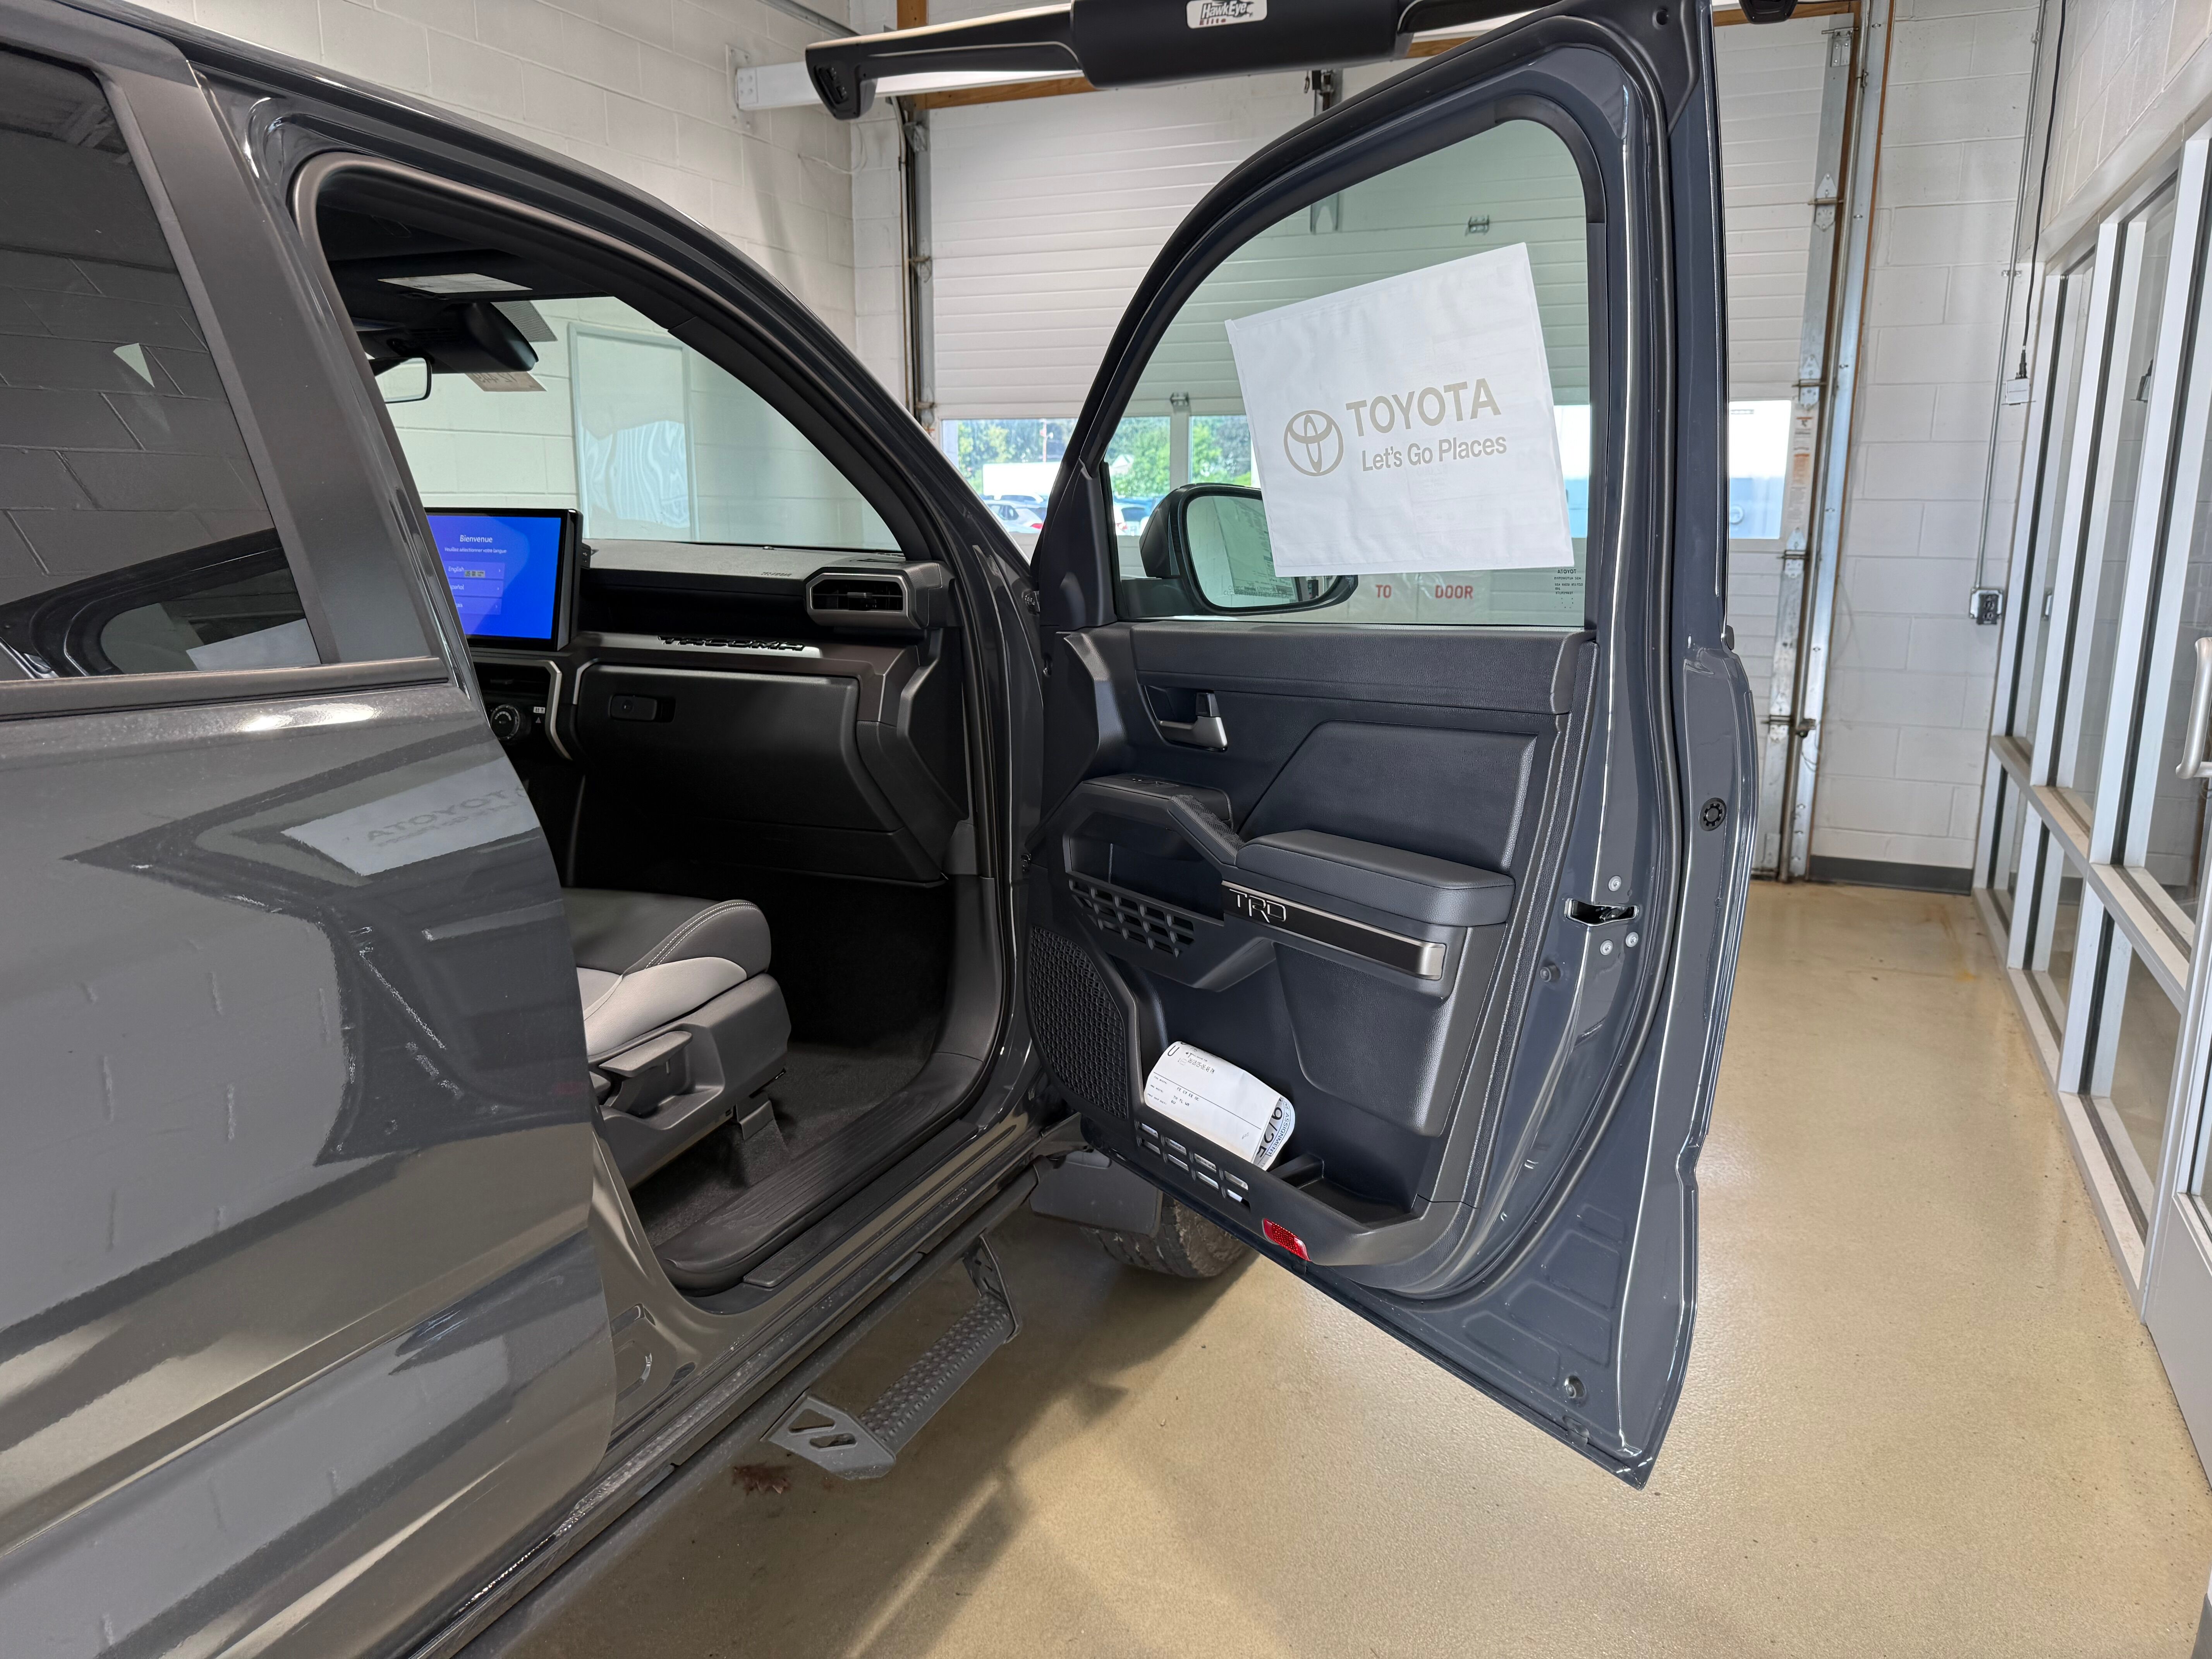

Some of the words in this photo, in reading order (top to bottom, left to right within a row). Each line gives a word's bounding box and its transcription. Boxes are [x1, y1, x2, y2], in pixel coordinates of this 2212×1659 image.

[1201, 0, 1247, 19] HawkEye
[1346, 378, 1501, 436] TOYOTA
[1362, 447, 1402, 472] Let's
[1407, 443, 1433, 465] Go
[1439, 436, 1507, 462] Places
[460, 534, 493, 543] Bienvenue
[1376, 585, 1391, 598] TO
[1435, 585, 1473, 599] DOOR
[657, 635, 805, 651] TACOMA
[1230, 888, 1286, 923] TRD
[1267, 1114, 1290, 1156] ASSIGNMENT
